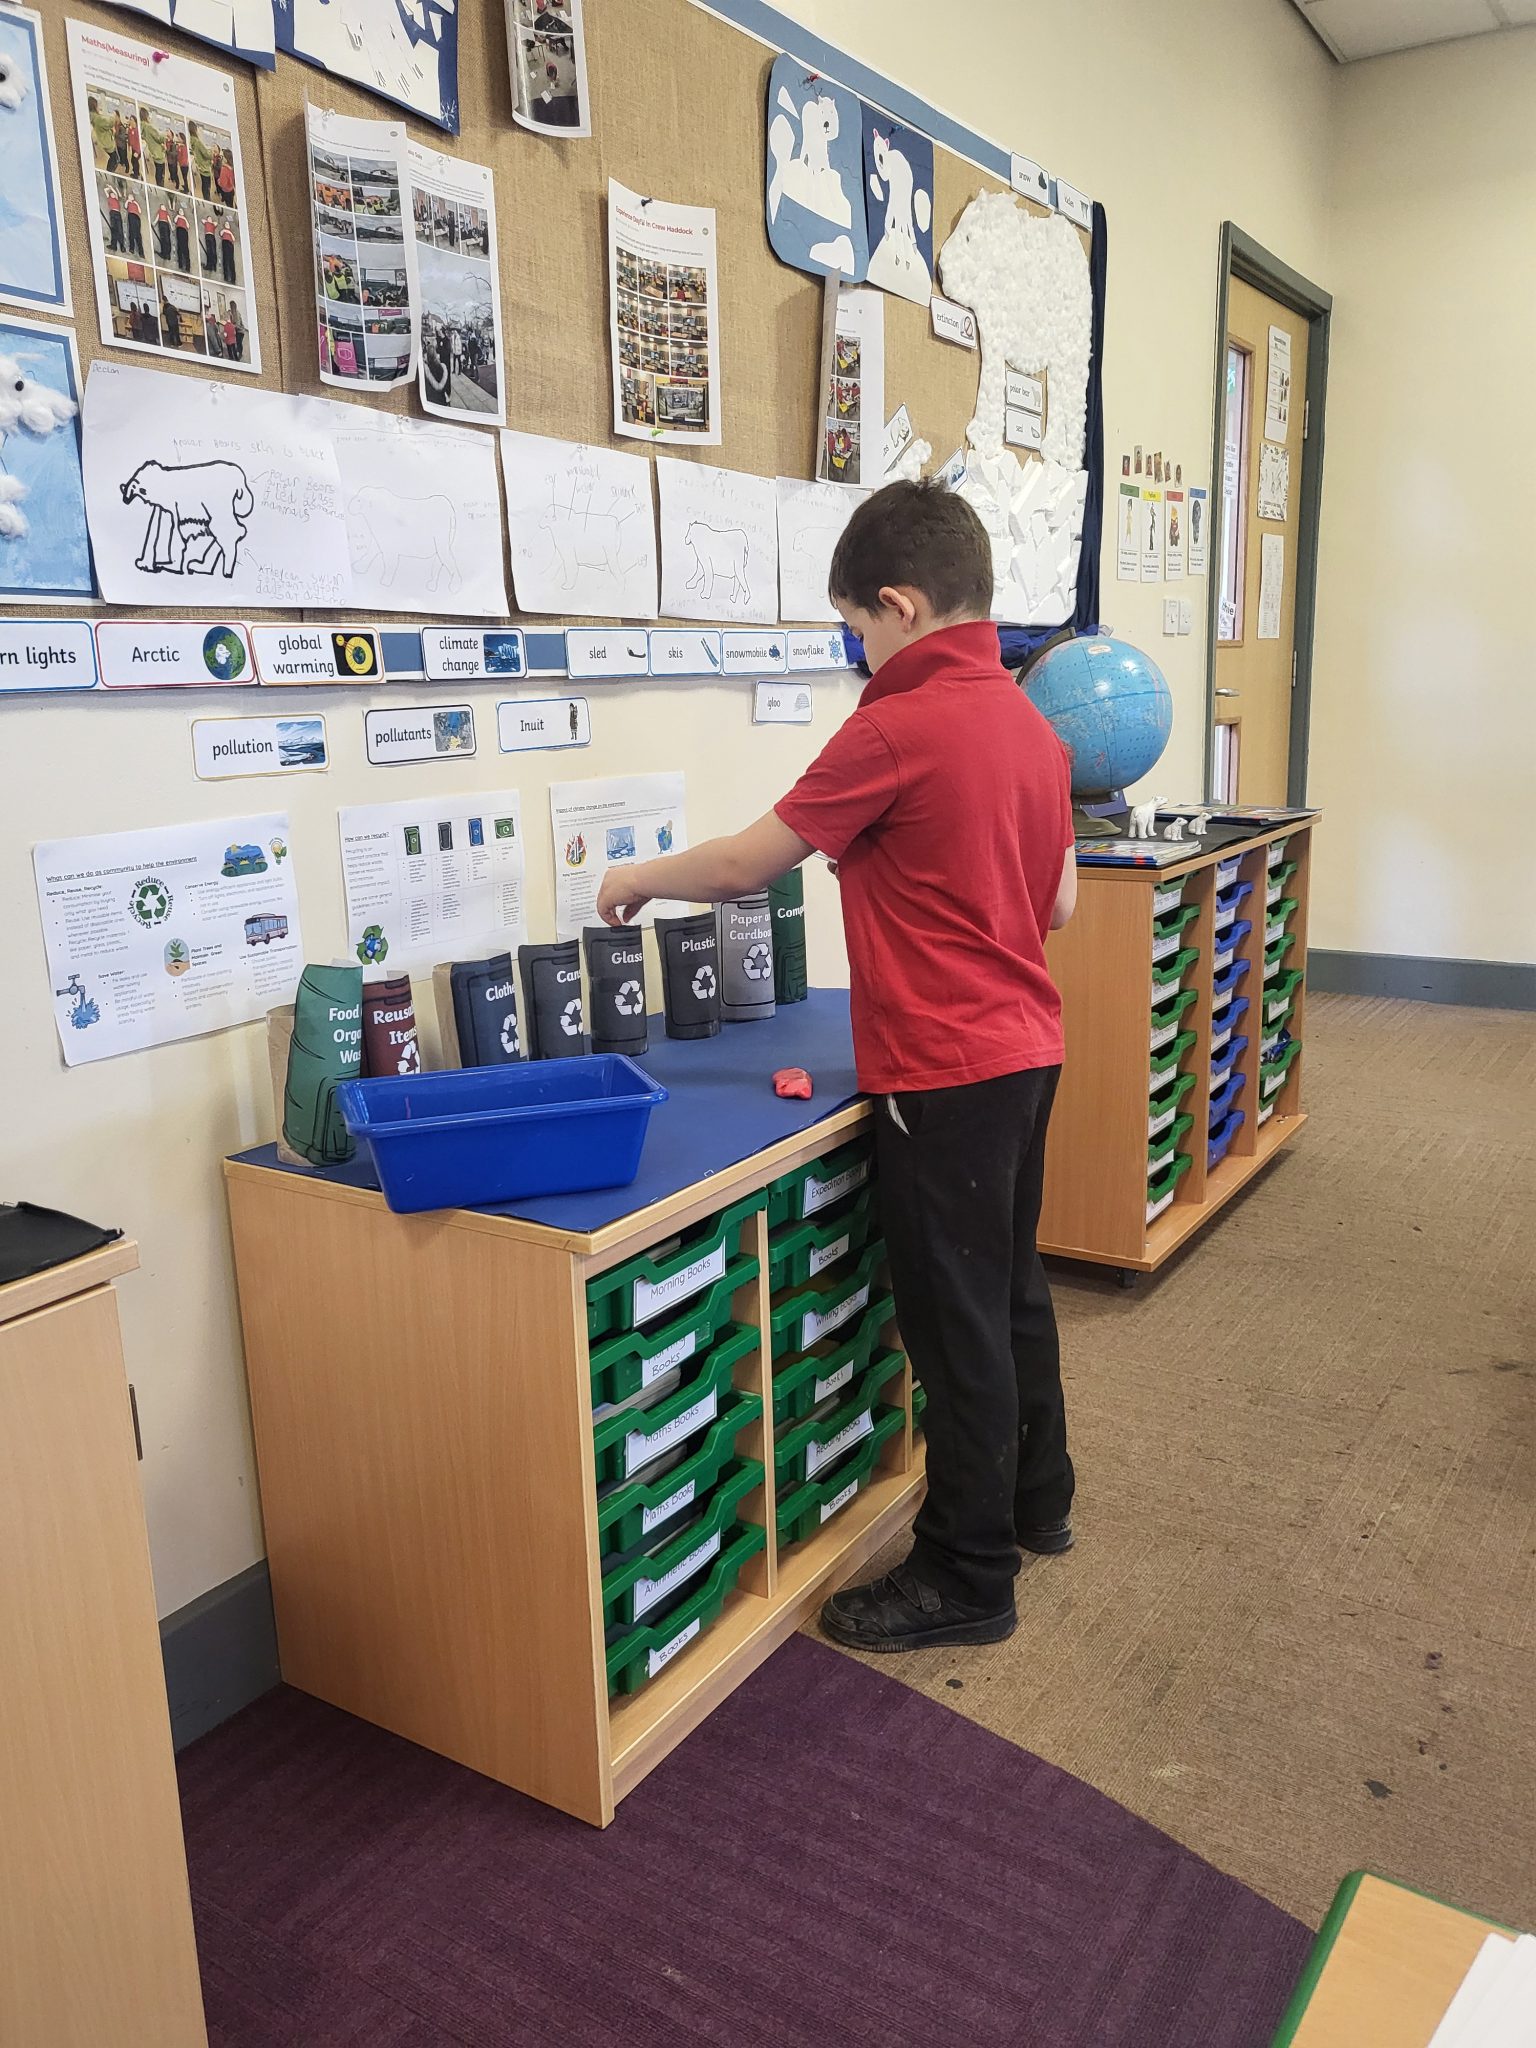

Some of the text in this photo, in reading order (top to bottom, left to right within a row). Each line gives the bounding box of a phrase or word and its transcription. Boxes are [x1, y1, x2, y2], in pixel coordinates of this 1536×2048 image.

[81, 34, 150, 67] Maths(Measuring)
[666, 224, 694, 236] Haddock
[936, 311, 960, 330] extinction
[278, 634, 322, 655] global
[439, 636, 479, 650] climate
[589, 646, 607, 659] sled
[668, 646, 684, 659] skis
[792, 644, 825, 658] snowflake
[26, 646, 77, 670] lights
[130, 645, 181, 665] Arctic
[725, 647, 768, 660] snowmobile
[272, 658, 335, 678] warming
[442, 657, 480, 676] change
[766, 696, 781, 709] igloo
[520, 719, 545, 732] Inuit
[375, 727, 432, 747] pollutants
[212, 739, 274, 761] pollution
[63, 873, 75, 881] can
[102, 864, 135, 875] community
[142, 862, 155, 870] help
[165, 856, 198, 865] environment
[134, 875, 164, 889] Reduce
[127, 900, 152, 930] Recycle
[162, 895, 174, 922] Reuse
[776, 905, 805, 919] Comp
[730, 913, 763, 928] Paper
[729, 928, 772, 941] Cardboa
[681, 937, 716, 953] Plastic
[611, 951, 643, 965] Glass
[485, 982, 516, 1002] Clothe
[329, 1003, 360, 1022] Food
[373, 1000, 415, 1025] Reusa
[333, 1028, 362, 1045] Orga
[340, 1049, 362, 1064] Was
[811, 1173, 845, 1199] Expedition
[818, 1246, 840, 1265] Books
[650, 1258, 712, 1300] Morning Books
[651, 1352, 681, 1377] Books
[645, 1405, 700, 1447] Maths Books
[644, 1484, 694, 1526] Maths Books
